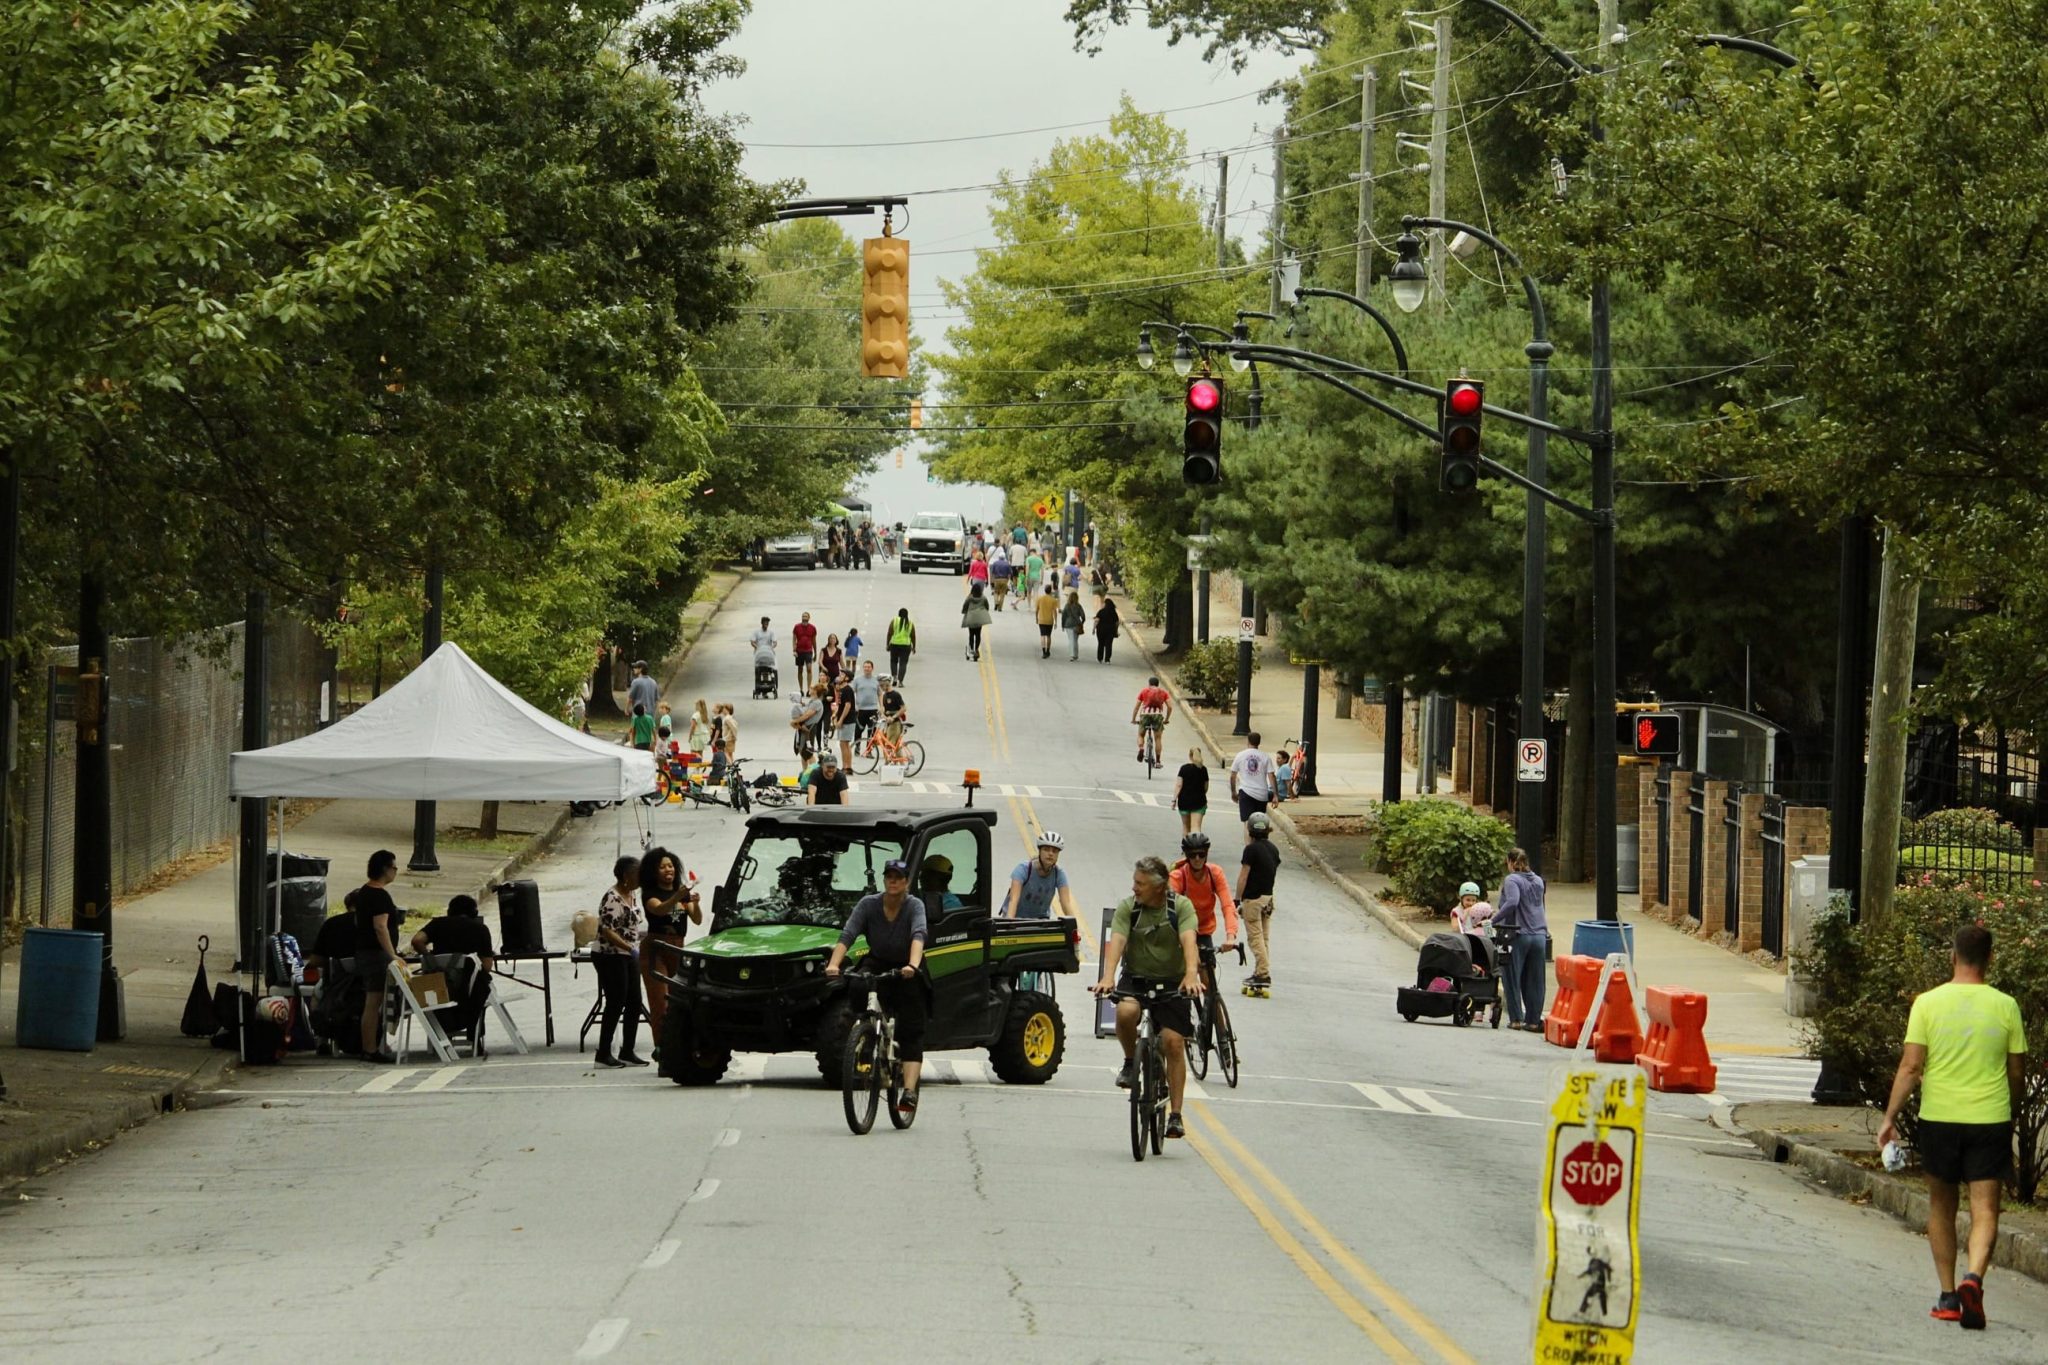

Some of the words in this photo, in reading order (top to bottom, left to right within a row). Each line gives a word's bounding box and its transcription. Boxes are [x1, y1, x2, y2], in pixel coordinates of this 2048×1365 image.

[1570, 1075, 1626, 1098] STTE
[1564, 1160, 1620, 1186] STOP
[1577, 1224, 1605, 1238] FOR
[1564, 1330, 1608, 1347] WITIN
[1543, 1345, 1622, 1365] CROWALK
